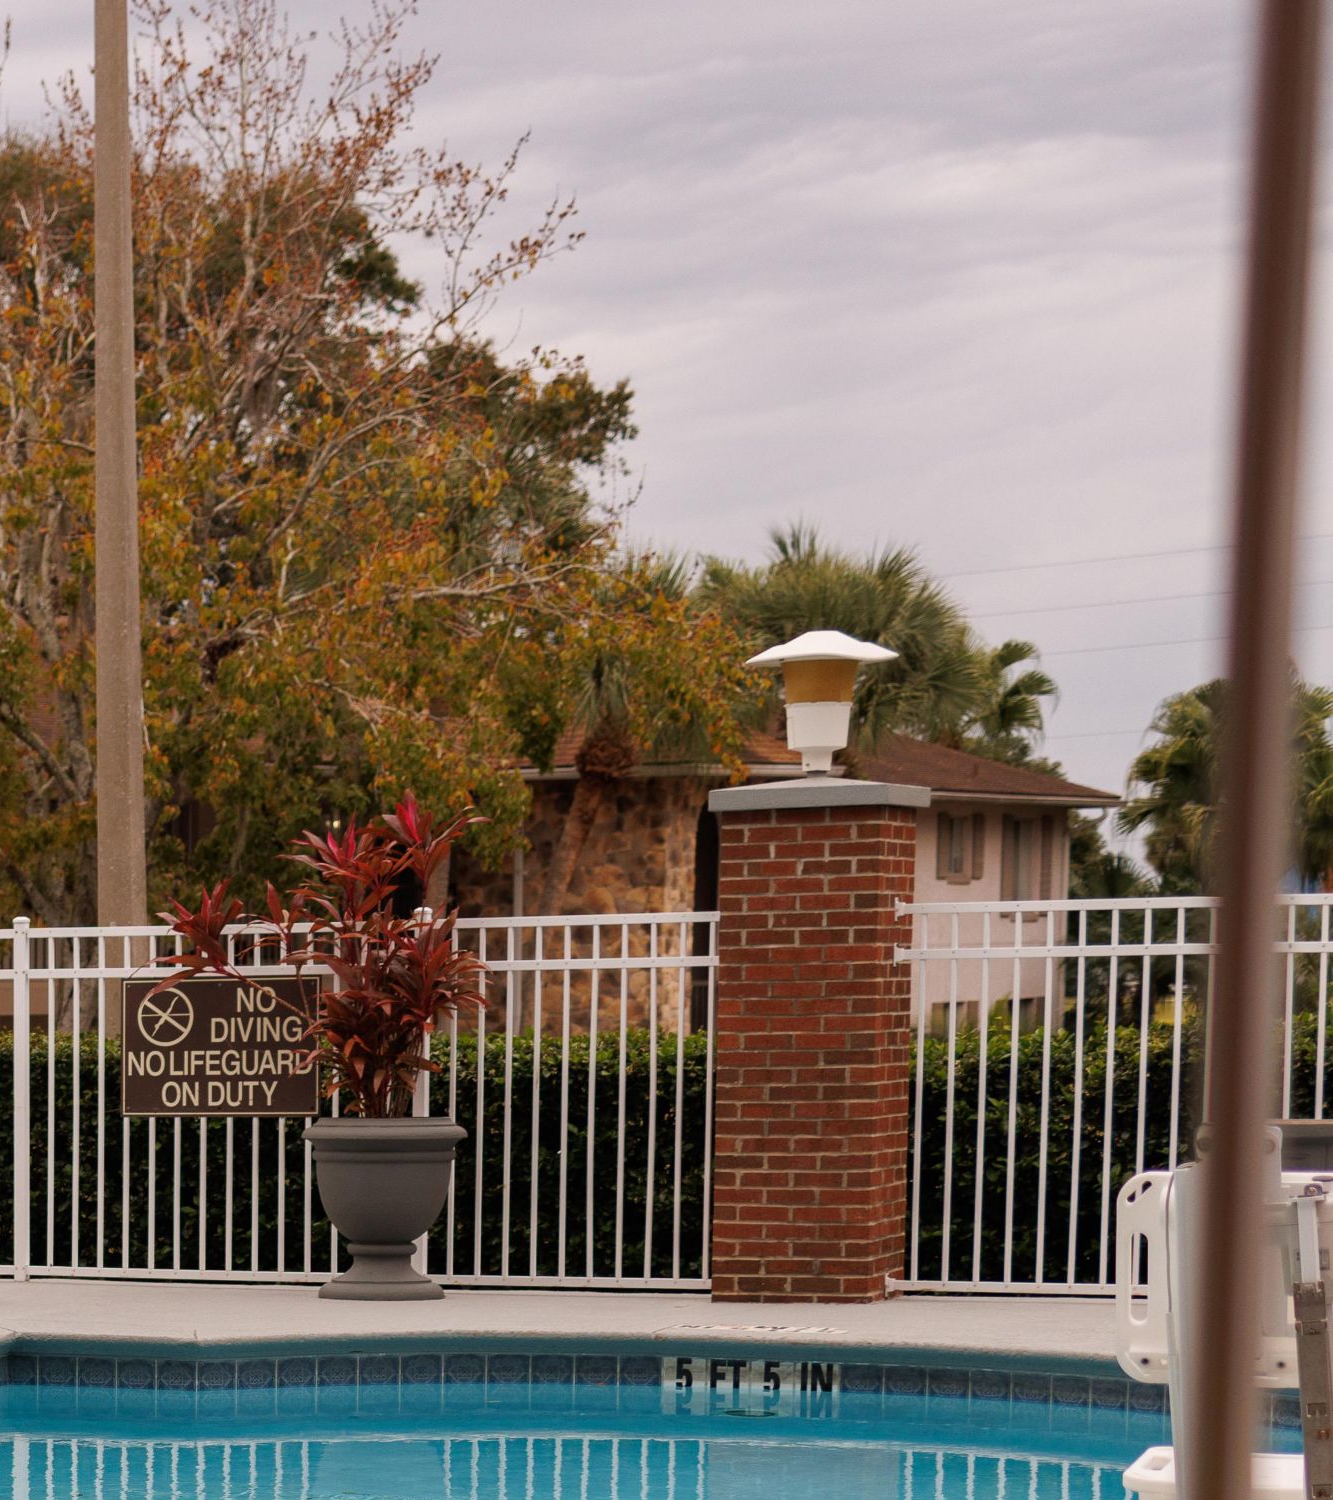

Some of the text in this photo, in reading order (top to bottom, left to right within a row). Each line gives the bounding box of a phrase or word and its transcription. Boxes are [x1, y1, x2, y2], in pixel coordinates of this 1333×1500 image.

[236, 986, 276, 1013] NO
[211, 1016, 302, 1043] DIVING
[128, 1049, 313, 1076] NO LIFEGUARD
[161, 1081, 278, 1107] ON DUTY
[676, 1357, 833, 1392] 5 FT 5 IN
